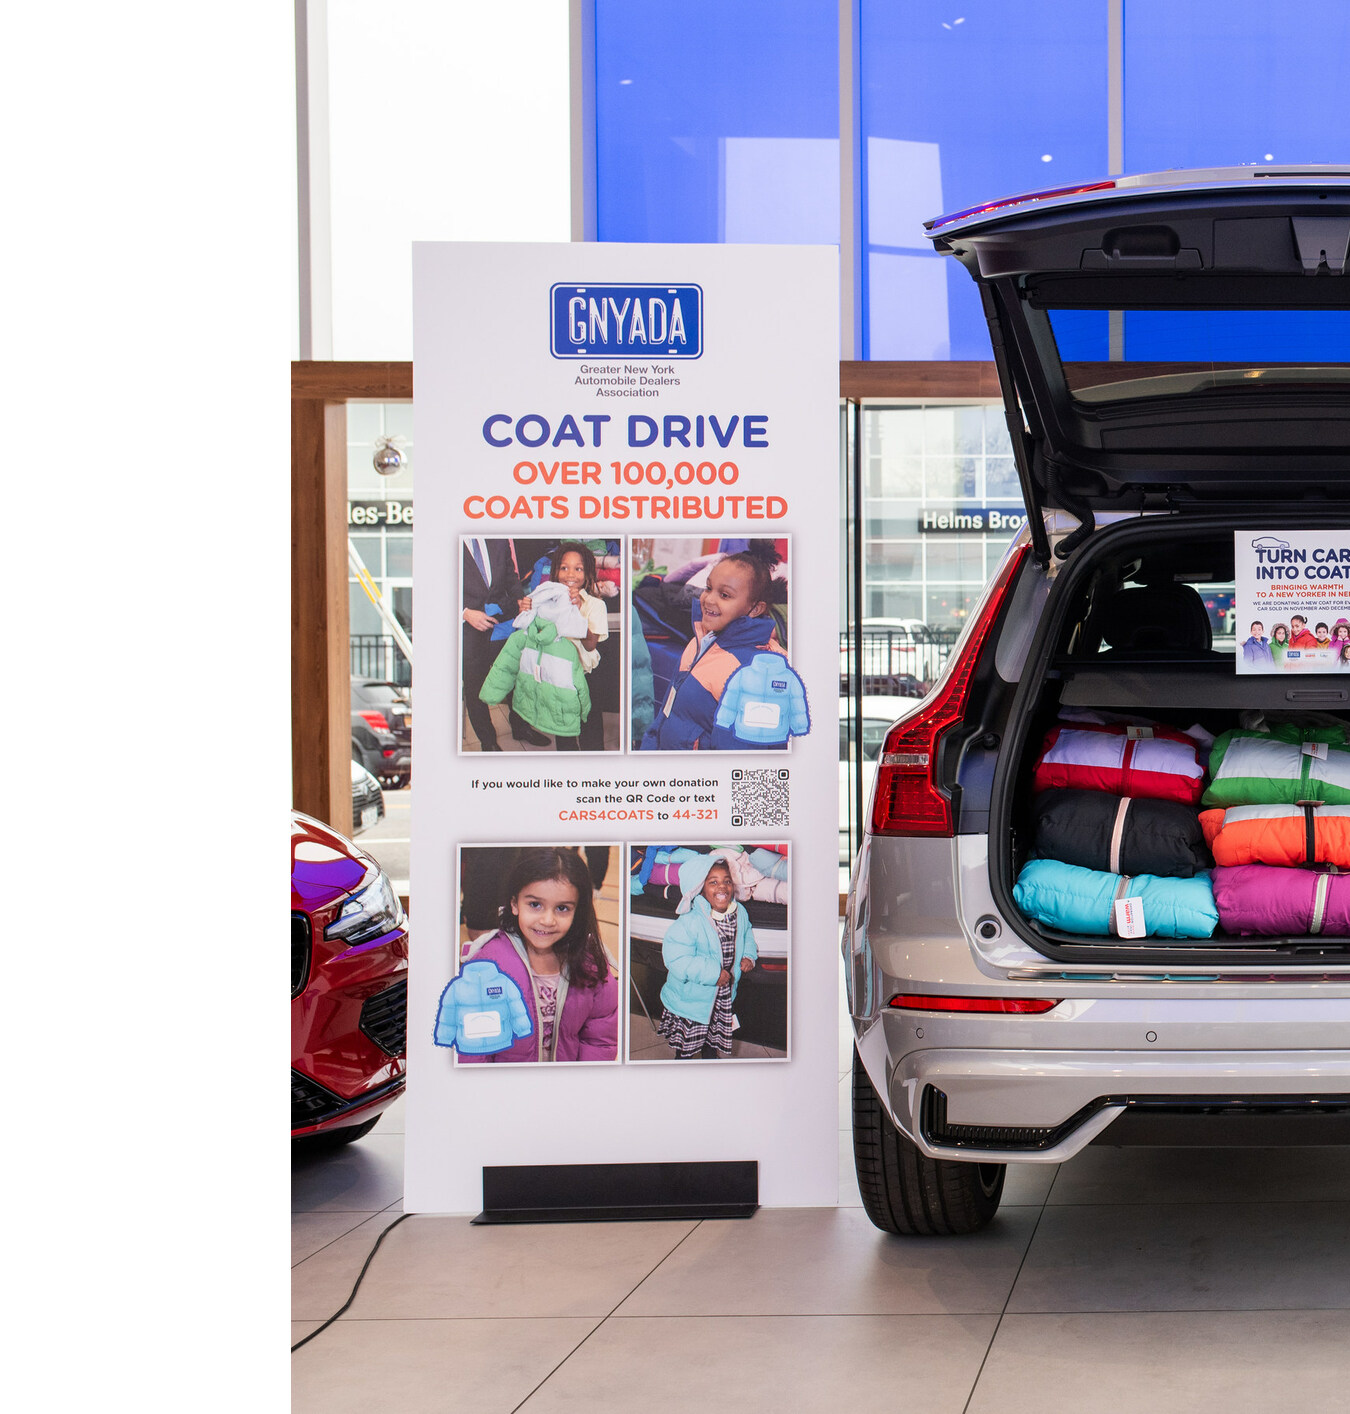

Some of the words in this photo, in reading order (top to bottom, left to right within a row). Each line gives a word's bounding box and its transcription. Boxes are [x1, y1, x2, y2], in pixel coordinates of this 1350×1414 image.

[569, 297, 686, 344] GNYADA
[580, 365, 621, 374] Greater
[624, 365, 648, 374] New
[652, 365, 674, 374] York
[575, 376, 636, 385] Automobile
[640, 376, 680, 385] Dealers
[596, 388, 659, 397] Association
[483, 414, 611, 447] COAT
[628, 415, 769, 448] DRIVE
[513, 461, 601, 485] OVER
[611, 461, 739, 490] 100,000
[463, 496, 569, 519] COATS
[580, 496, 788, 519] DISTRIBUTED
[923, 511, 983, 529] Helms
[1255, 548, 1306, 563] TURN
[1257, 566, 1299, 579] INTO
[472, 780, 479, 788] If
[483, 782, 502, 790] you
[506, 780, 540, 788] would
[544, 779, 563, 788] like
[582, 779, 611, 787] make
[615, 781, 639, 789] your
[669, 778, 718, 787] donation
[605, 795, 622, 803] the
[626, 795, 642, 803] QR
[647, 794, 675, 802] Code
[694, 794, 715, 802] text
[559, 810, 654, 820] CARS4COATS
[658, 812, 669, 820] to
[673, 809, 717, 819] 44-321
